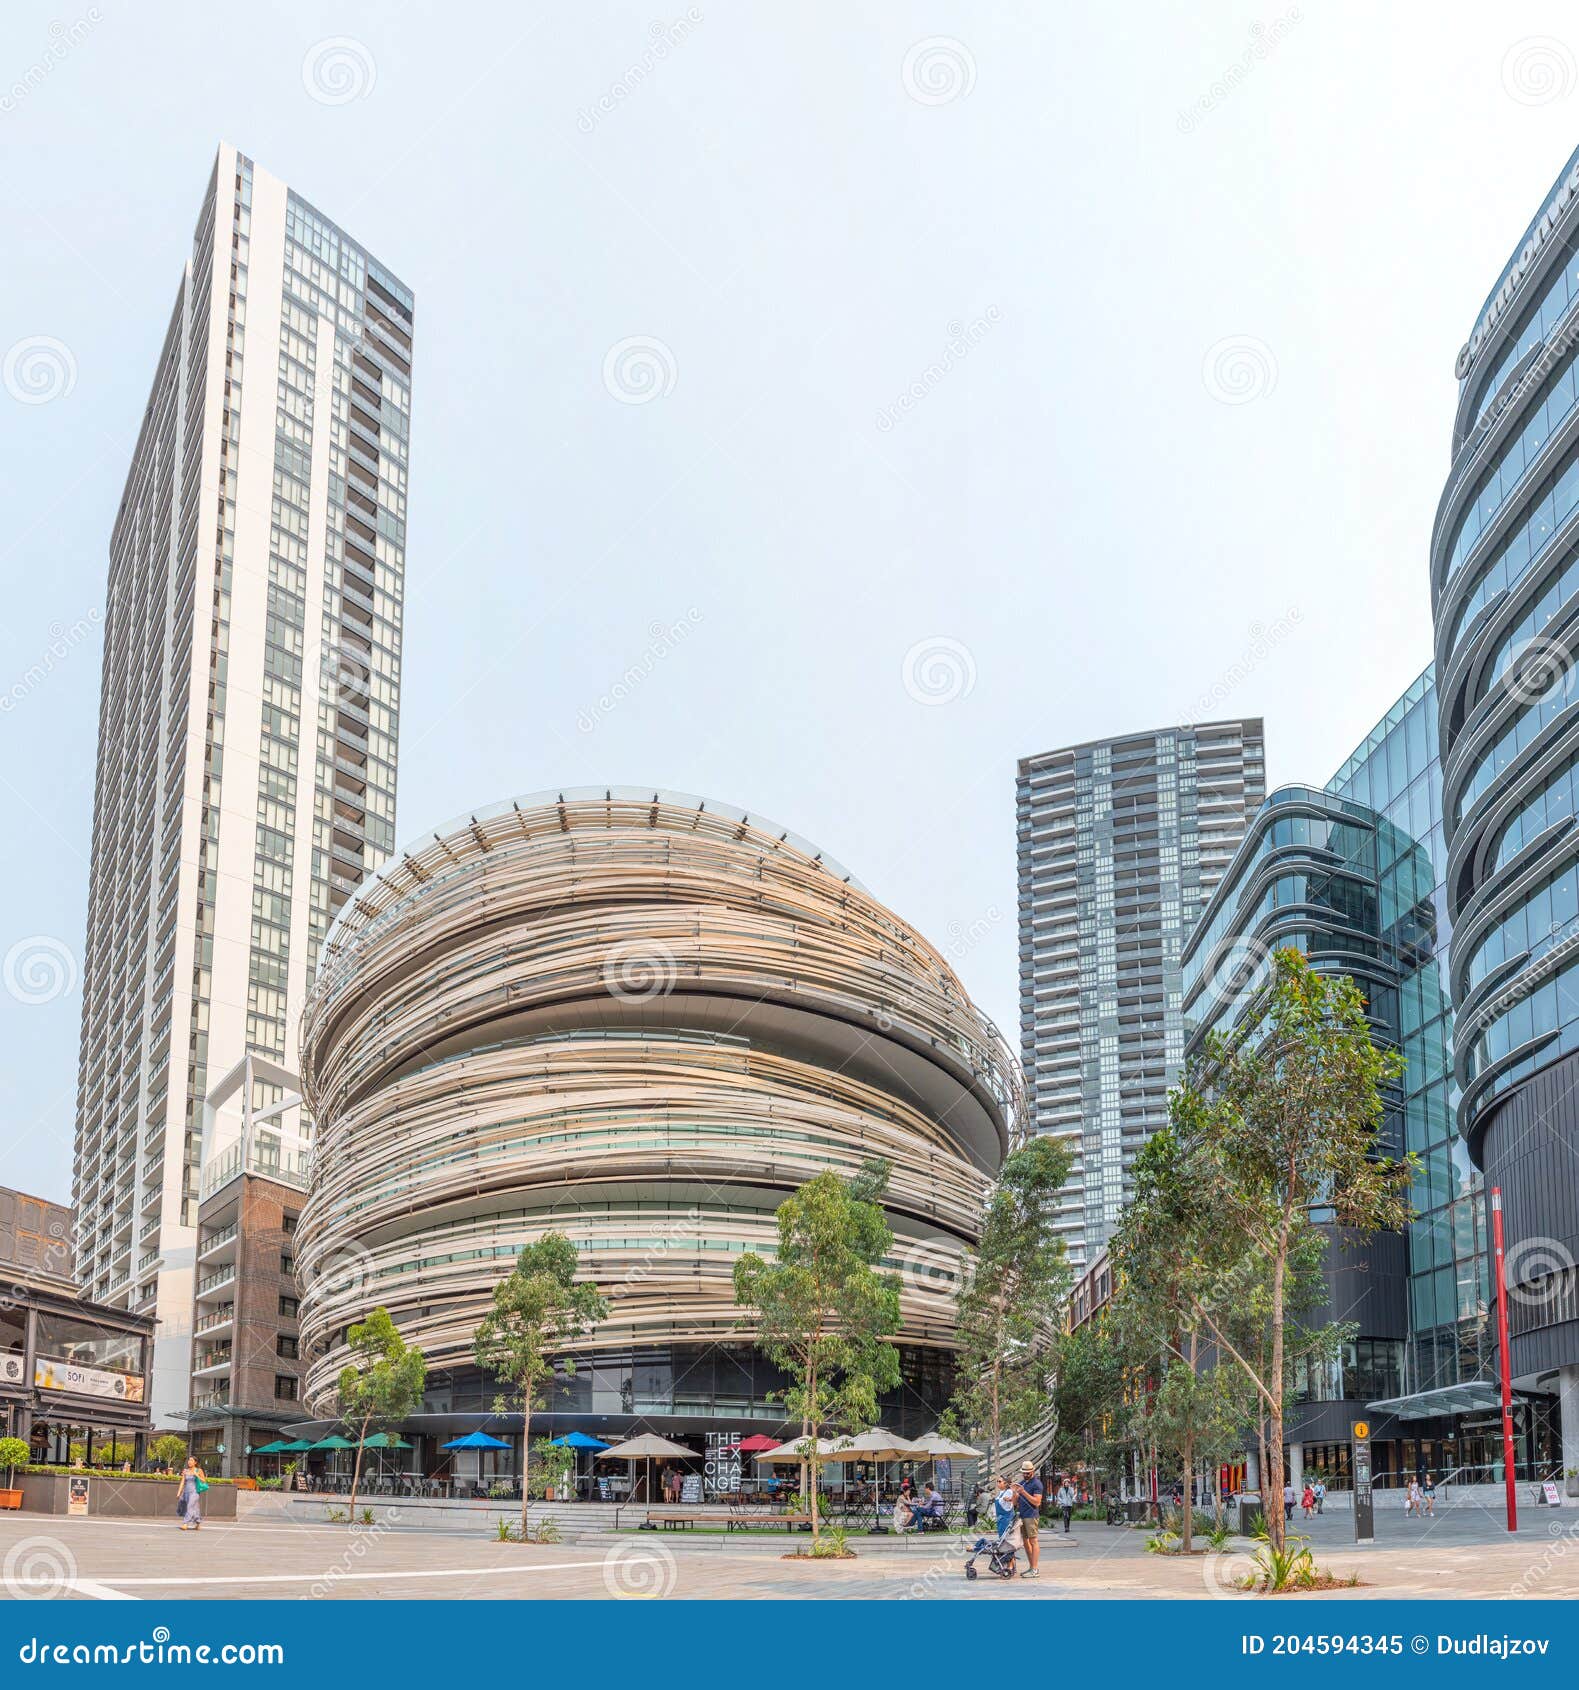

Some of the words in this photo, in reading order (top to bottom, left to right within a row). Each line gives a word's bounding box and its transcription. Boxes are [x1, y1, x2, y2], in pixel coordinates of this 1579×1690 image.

[705, 1432, 741, 1445] THE
[718, 1447, 741, 1460] EX
[704, 1461, 742, 1475] CHA
[704, 1476, 741, 1490] NGE
